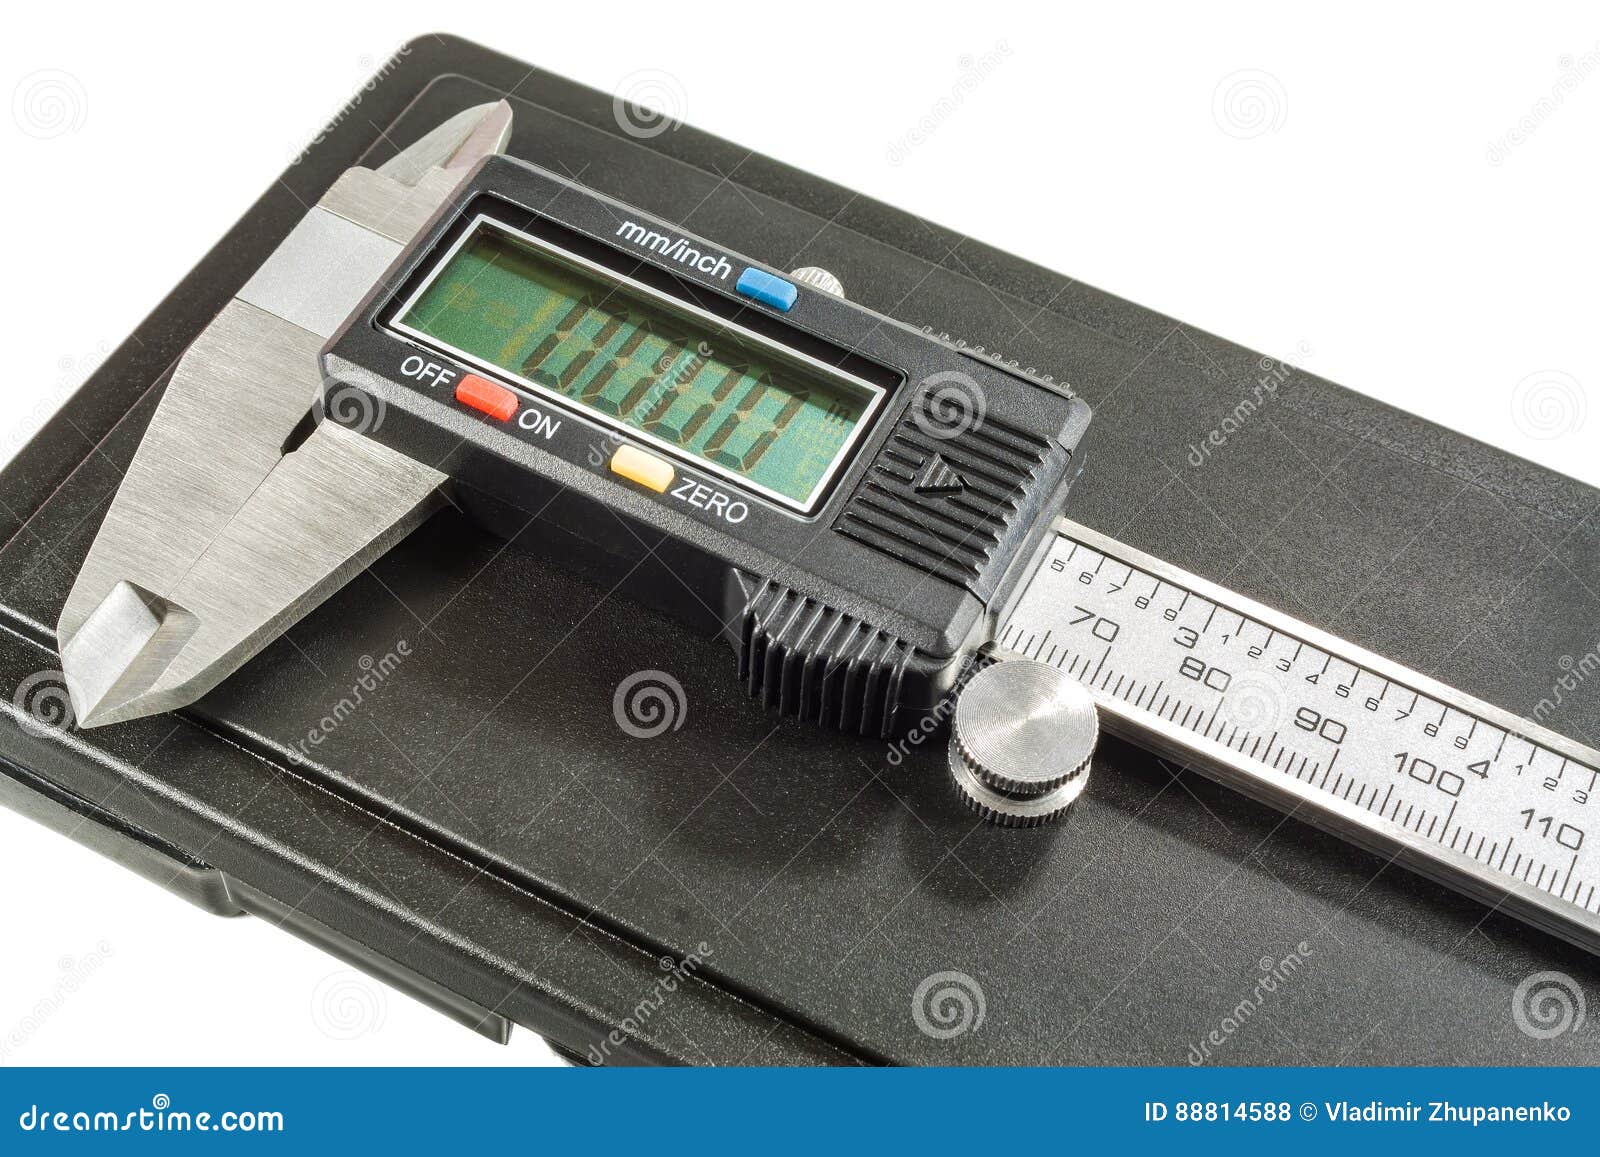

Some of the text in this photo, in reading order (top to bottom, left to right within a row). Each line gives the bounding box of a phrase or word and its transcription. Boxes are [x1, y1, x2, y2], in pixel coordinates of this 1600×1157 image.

[616, 220, 732, 280] mm/inch
[400, 355, 457, 388] OFF
[518, 408, 562, 440] ON
[670, 476, 748, 524] ZERO
[1051, 558, 1589, 805] 5 6 7 8 9 3 1 2 3 4 5 6 7 8 9 4 1 2 3
[1069, 605, 1585, 851] 70 80 90 100 110
